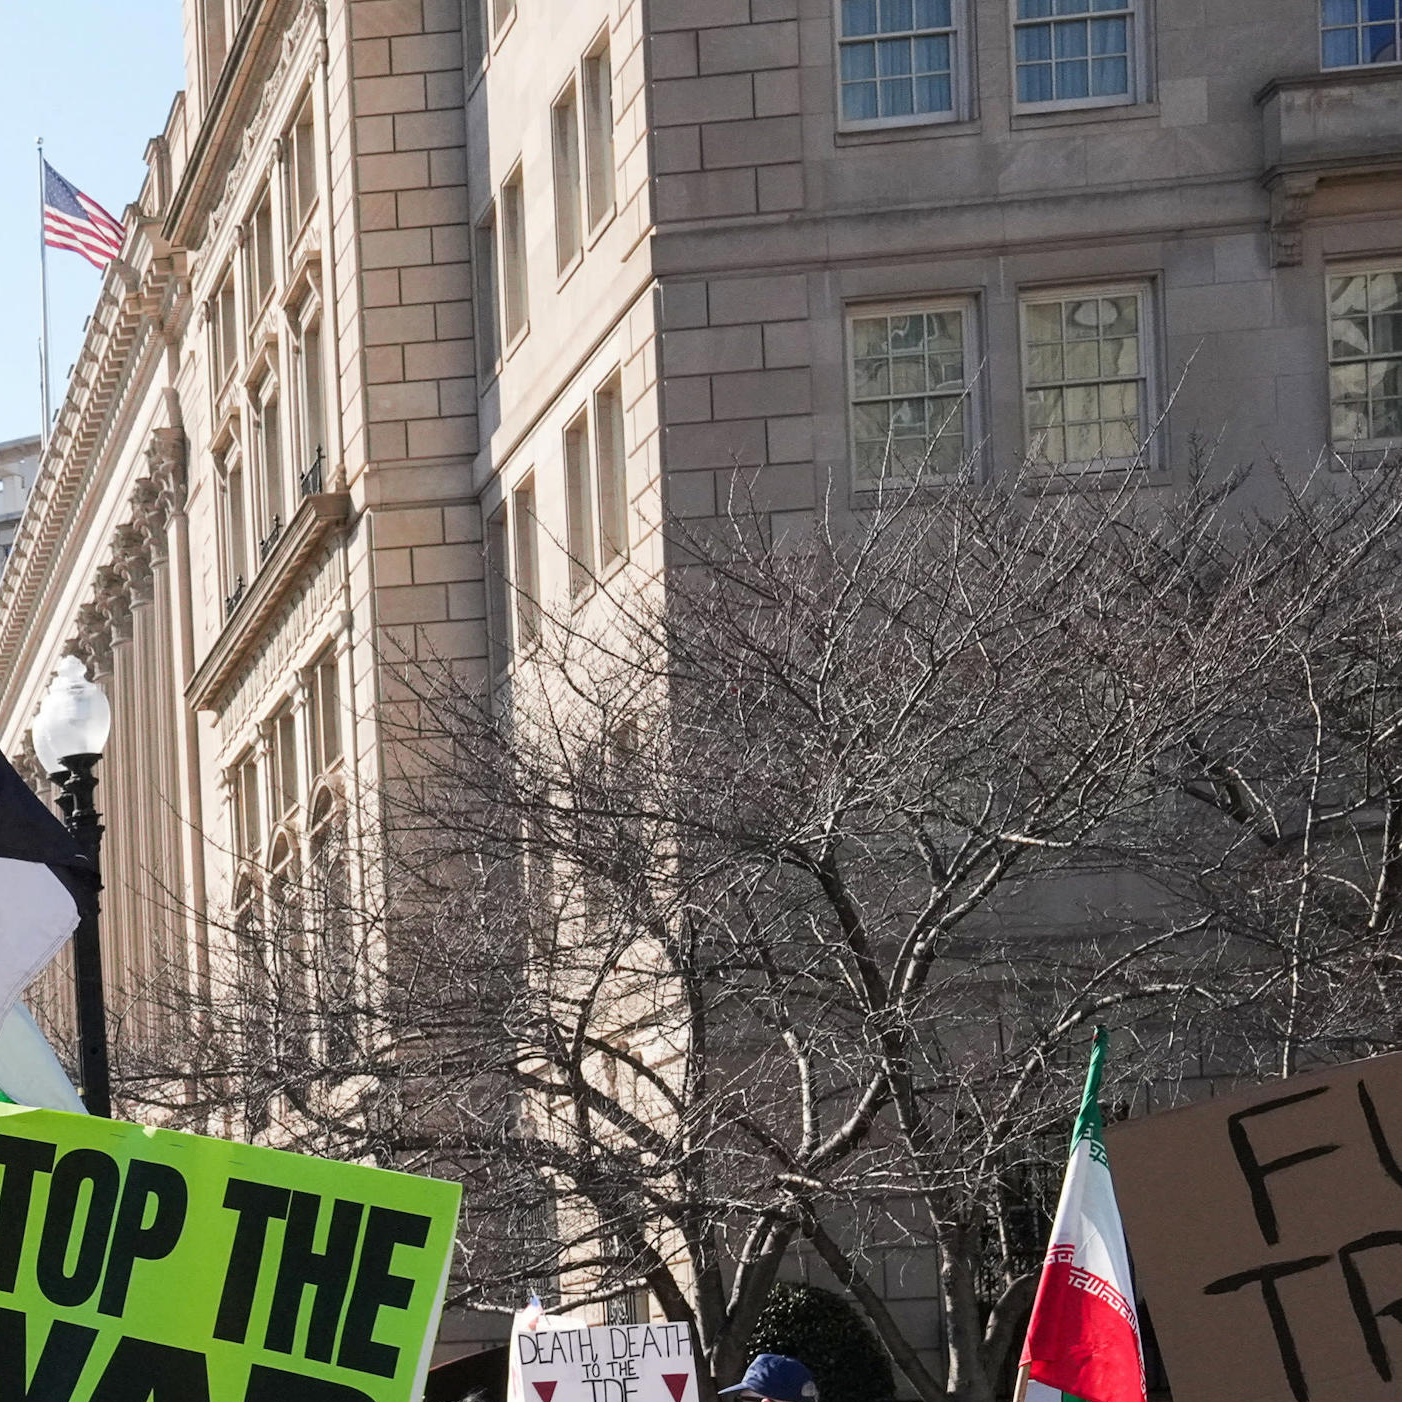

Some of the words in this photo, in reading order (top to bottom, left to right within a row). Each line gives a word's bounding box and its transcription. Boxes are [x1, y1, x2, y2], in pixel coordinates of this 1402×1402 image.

[212, 1176, 431, 1379] THE
[518, 1327, 599, 1366] DEATH,
[610, 1324, 694, 1360] DEATH
[582, 1362, 601, 1379] TO
[606, 1359, 637, 1377] THE
